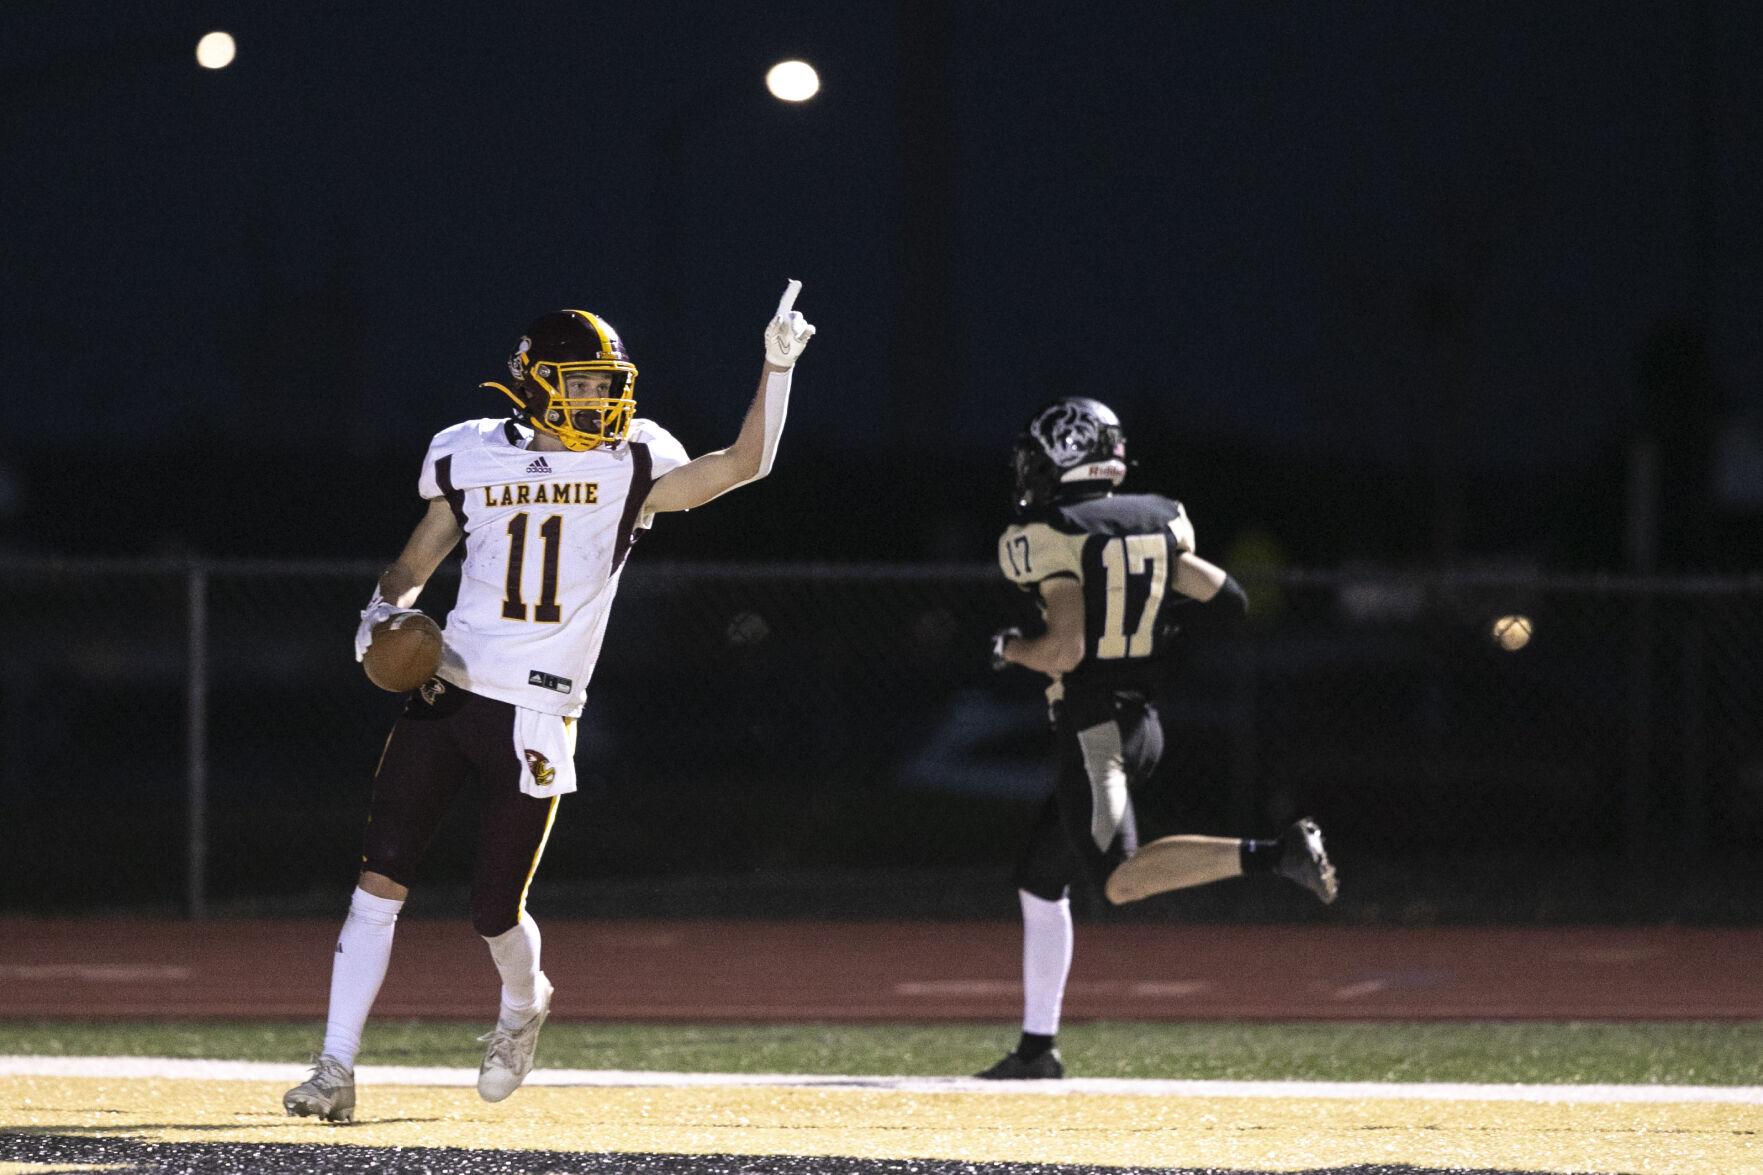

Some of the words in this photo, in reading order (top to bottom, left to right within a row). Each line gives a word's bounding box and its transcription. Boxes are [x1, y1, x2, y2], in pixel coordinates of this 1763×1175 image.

[484, 482, 599, 508] LARAMIE
[501, 512, 564, 624] 11
[1006, 535, 1032, 577] 17
[1097, 533, 1168, 659] 17
